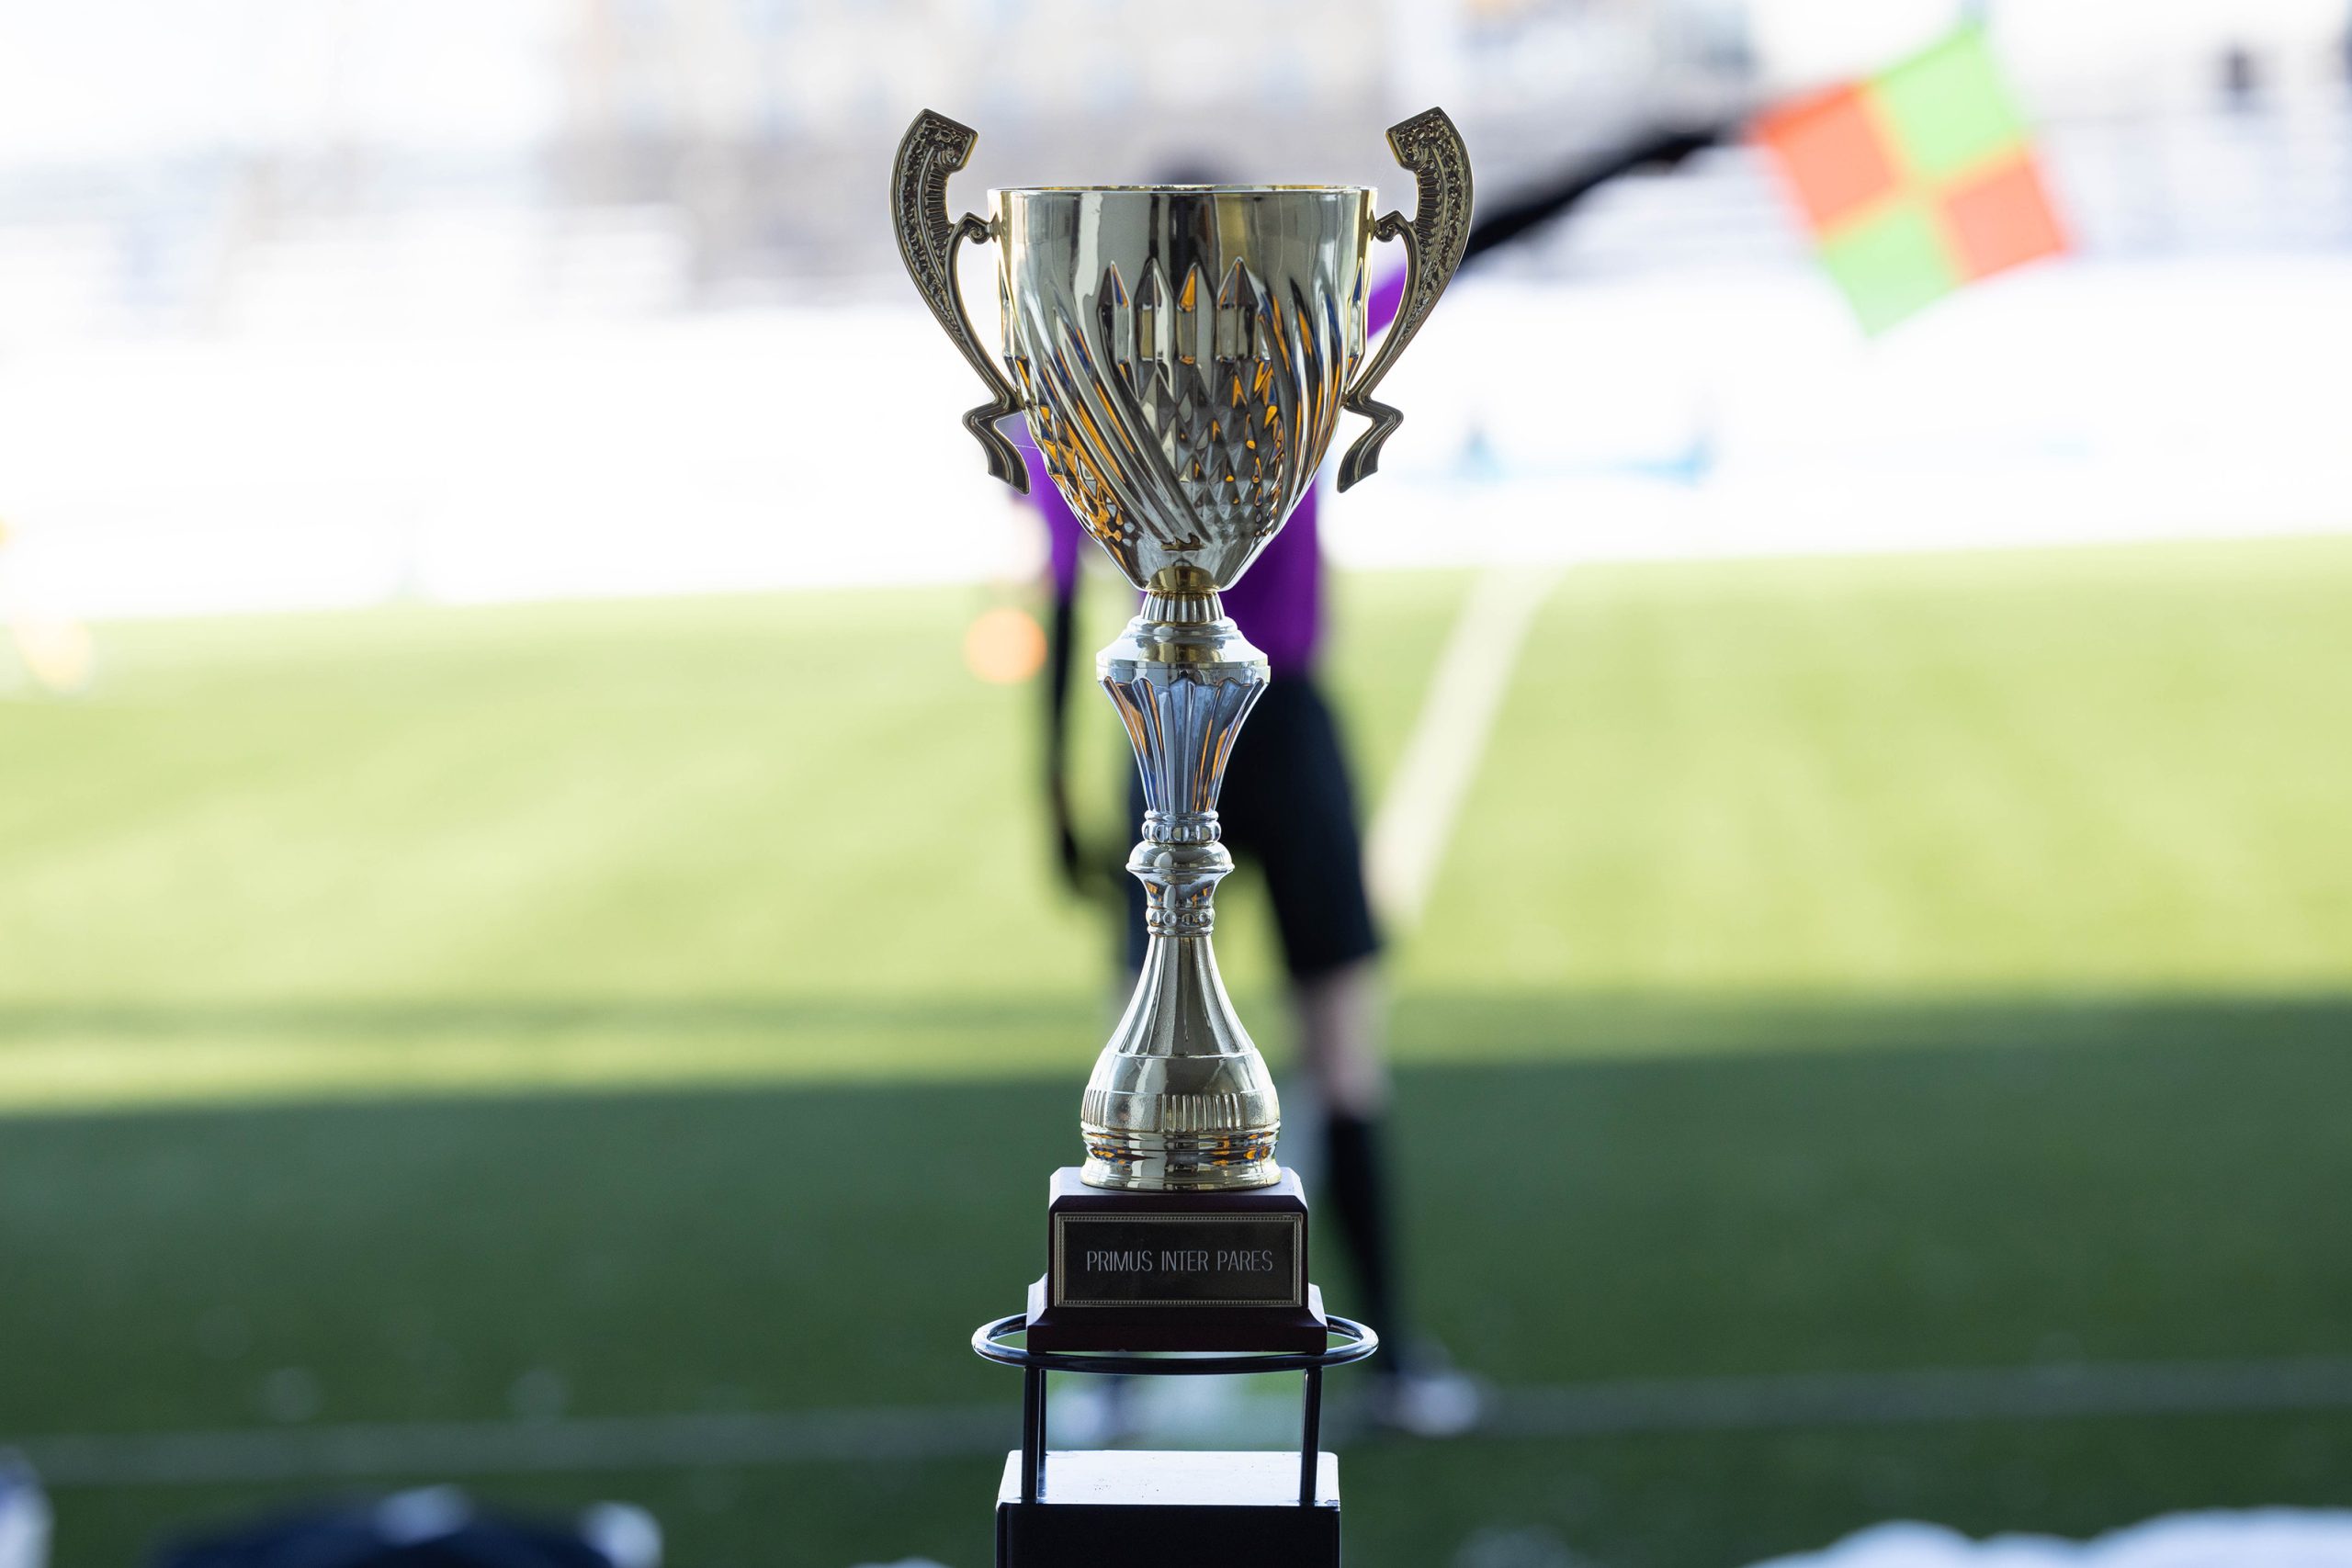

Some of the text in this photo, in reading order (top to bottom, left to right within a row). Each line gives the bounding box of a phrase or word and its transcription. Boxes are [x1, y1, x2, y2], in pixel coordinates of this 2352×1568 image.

[1086, 1249, 1273, 1272] PRIMUS INTER PARES
